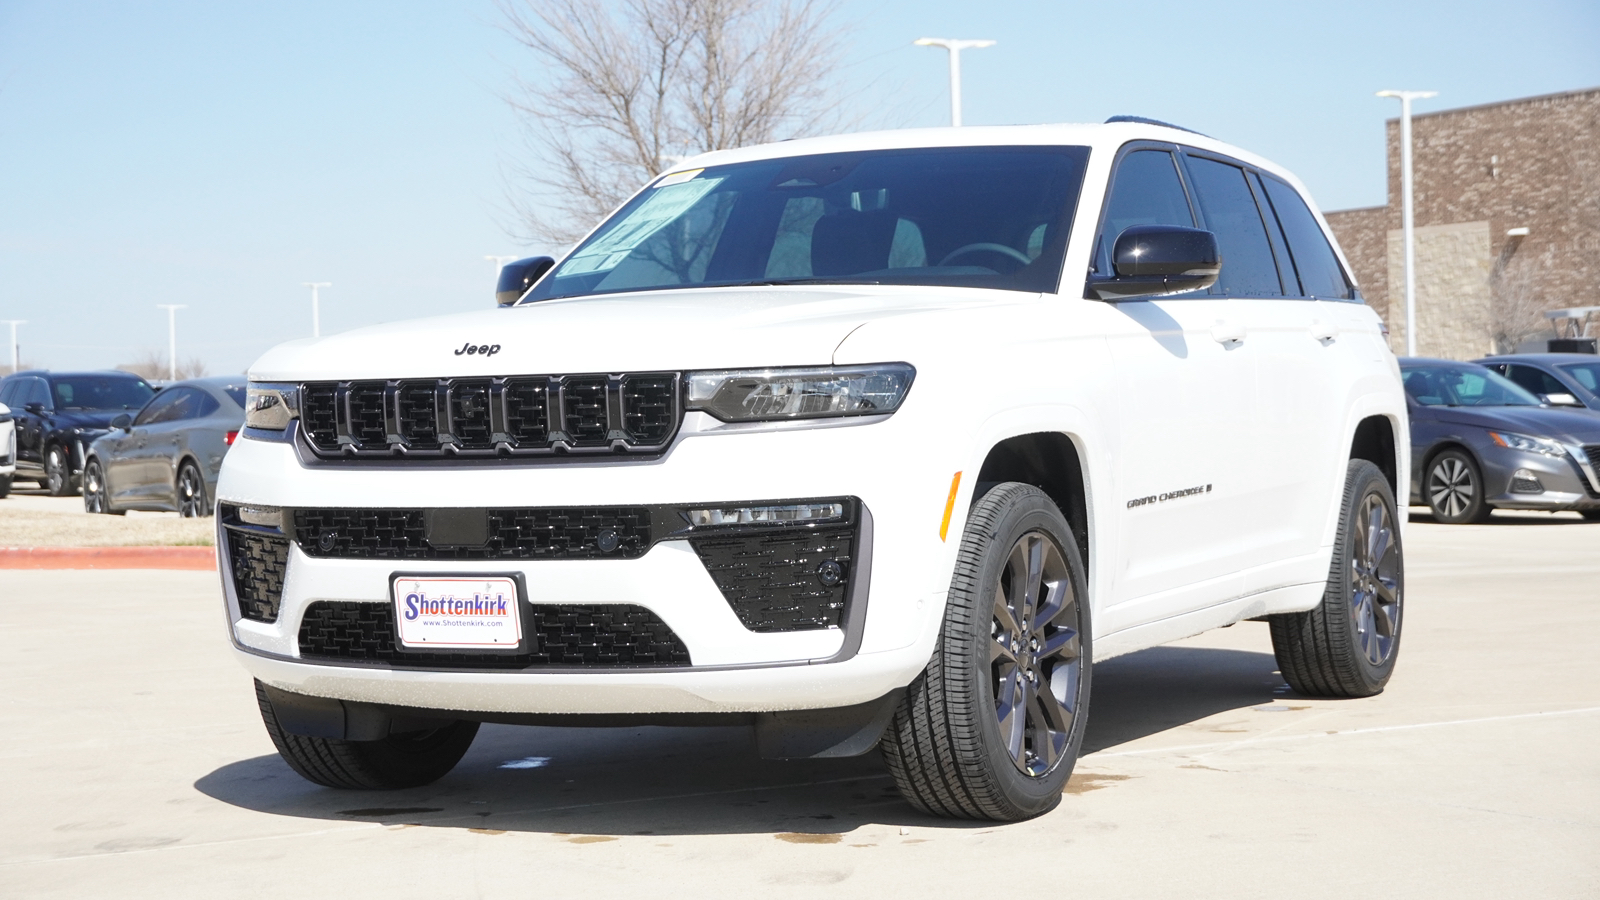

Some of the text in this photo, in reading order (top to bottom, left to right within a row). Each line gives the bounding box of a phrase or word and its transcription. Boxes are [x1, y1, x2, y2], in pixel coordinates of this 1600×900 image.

[454, 342, 501, 357] Jeep
[1126, 486, 1204, 509] GRAND CHEROKEE
[405, 593, 507, 620] Shottenkirk
[423, 619, 503, 627] www.Shottenkirk.com
